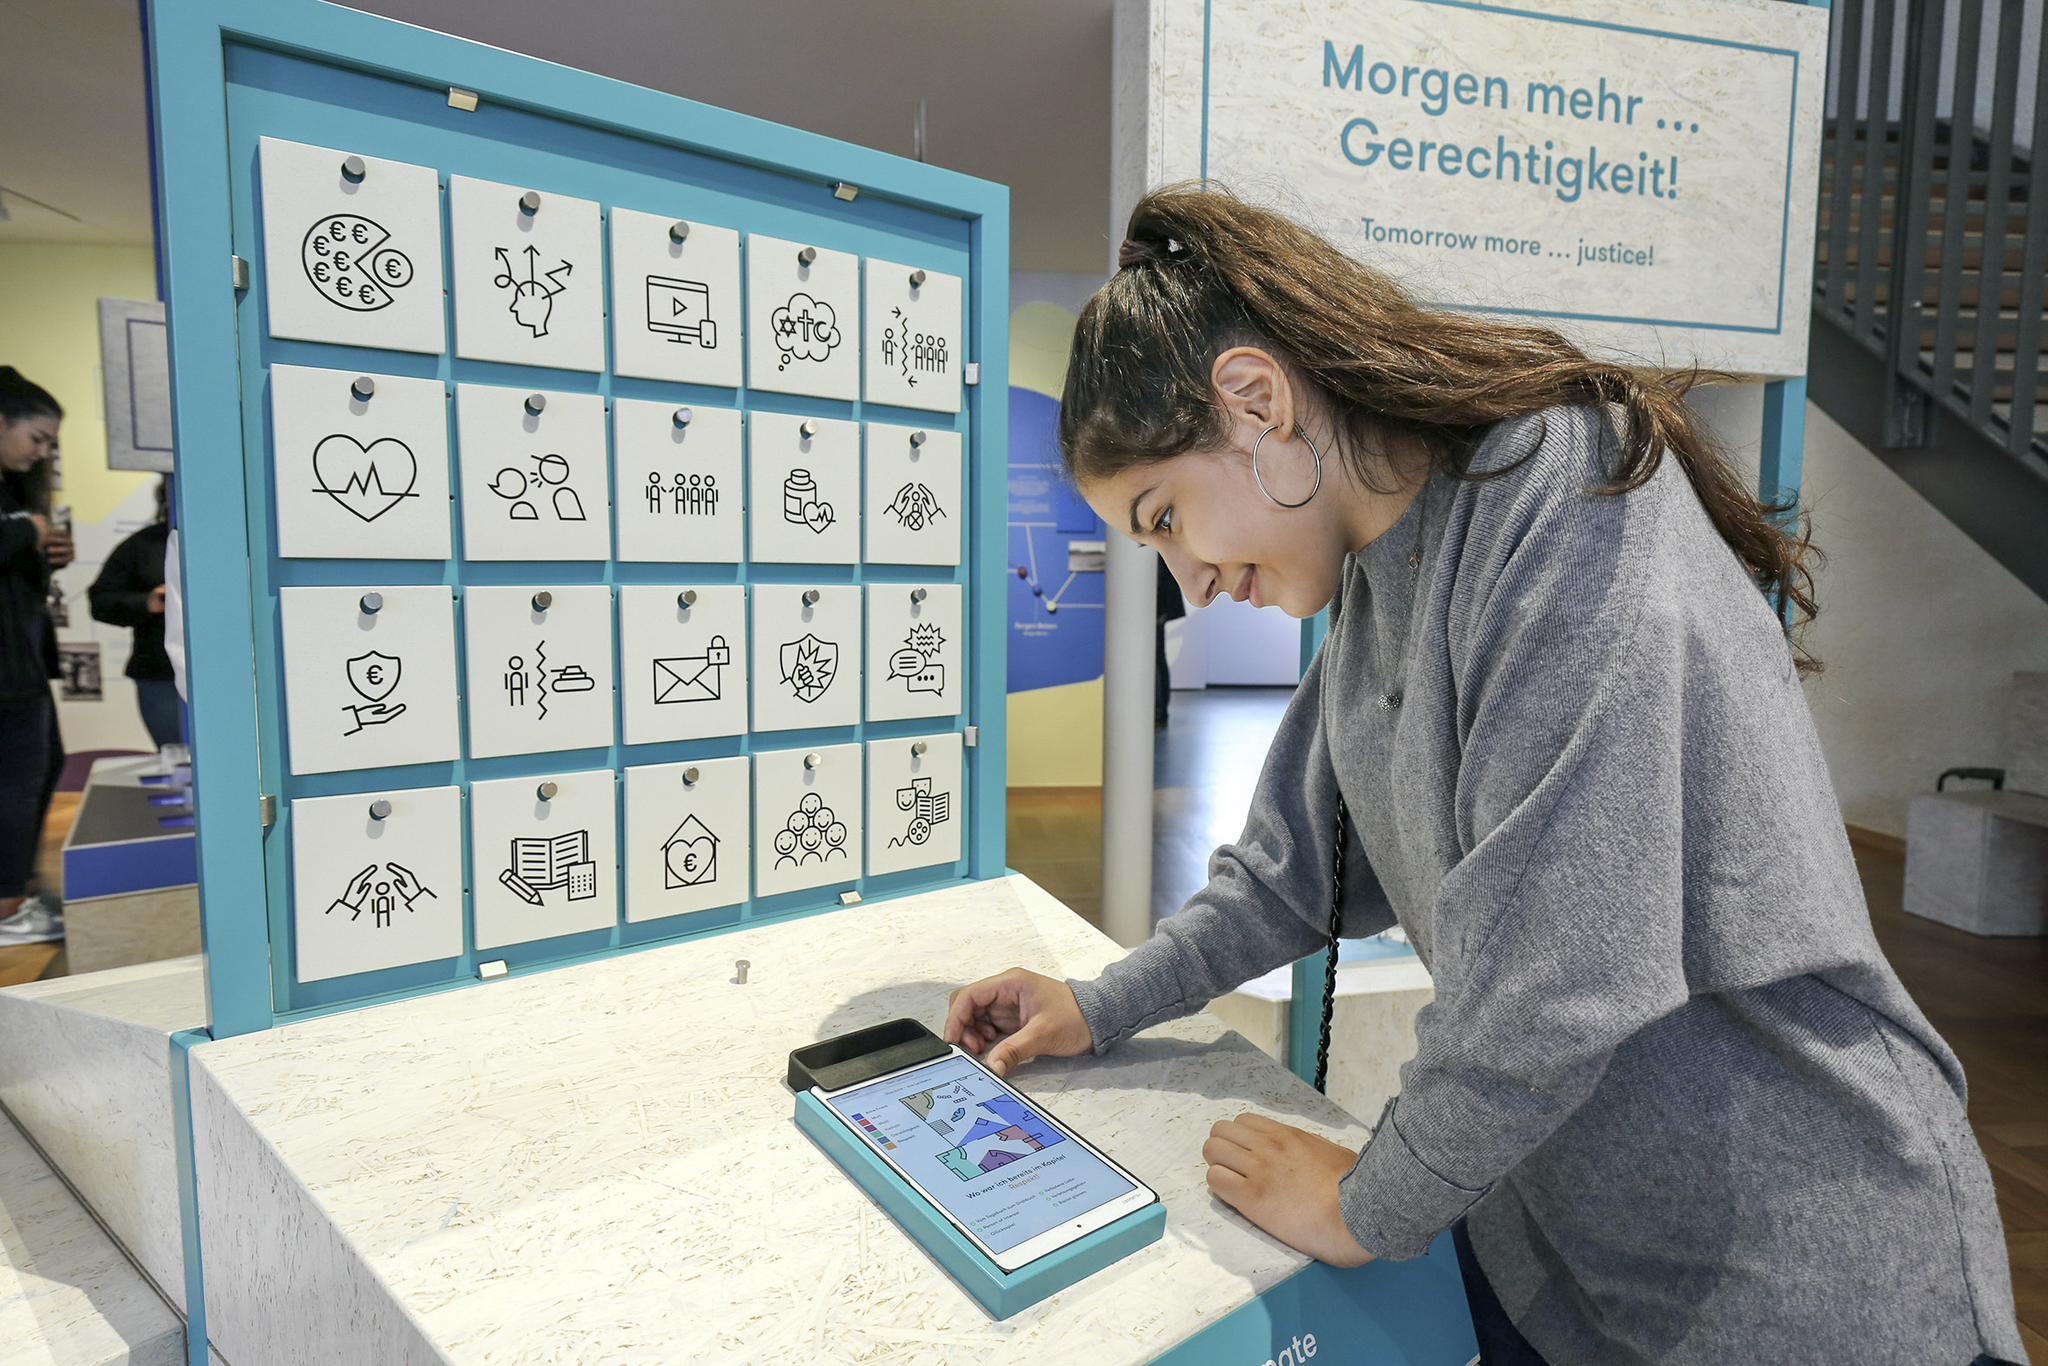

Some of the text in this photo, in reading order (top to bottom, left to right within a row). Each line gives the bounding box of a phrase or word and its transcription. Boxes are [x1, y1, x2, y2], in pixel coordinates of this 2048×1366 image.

[1324, 41, 1508, 116] Morgen
[1528, 78, 1643, 124] mehr
[1341, 117, 1678, 203] Gerechtigkeit!
[1361, 217, 1477, 251] Tomorrow
[1484, 234, 1541, 256] more
[1577, 238, 1655, 267] justice!
[966, 1154, 1066, 1199] Wo war ich bereits im Kapitel
[1259, 1333, 1318, 1366] ate
